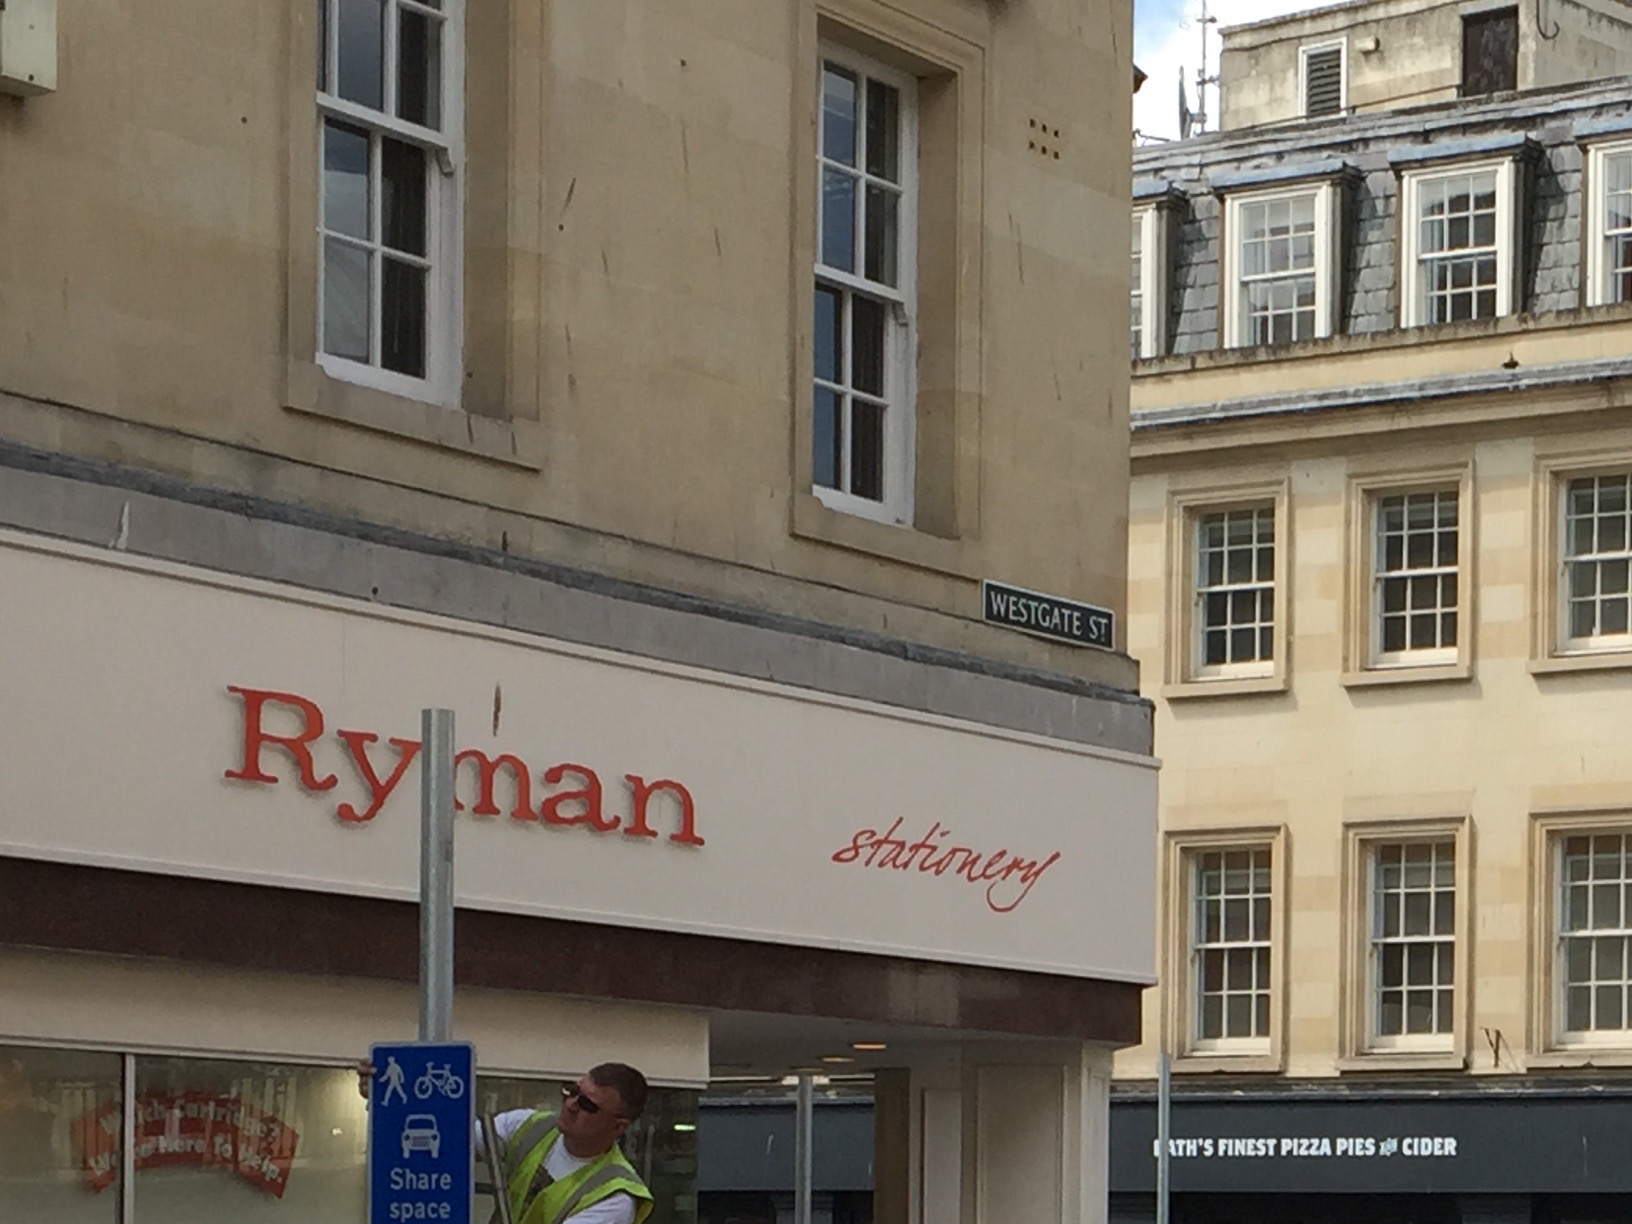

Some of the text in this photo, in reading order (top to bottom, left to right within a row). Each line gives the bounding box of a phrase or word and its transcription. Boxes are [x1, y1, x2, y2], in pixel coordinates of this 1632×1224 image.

[990, 590, 1109, 642] WESTGATE ST
[224, 685, 706, 846] Ryman
[831, 816, 1061, 913] stationery
[1218, 1138, 1277, 1157] FINEST
[1281, 1138, 1332, 1156] PIZZA
[1335, 1138, 1376, 1156] PIES
[1402, 1137, 1457, 1156] CIDER
[390, 1167, 452, 1191] Share
[389, 1201, 452, 1223] space
